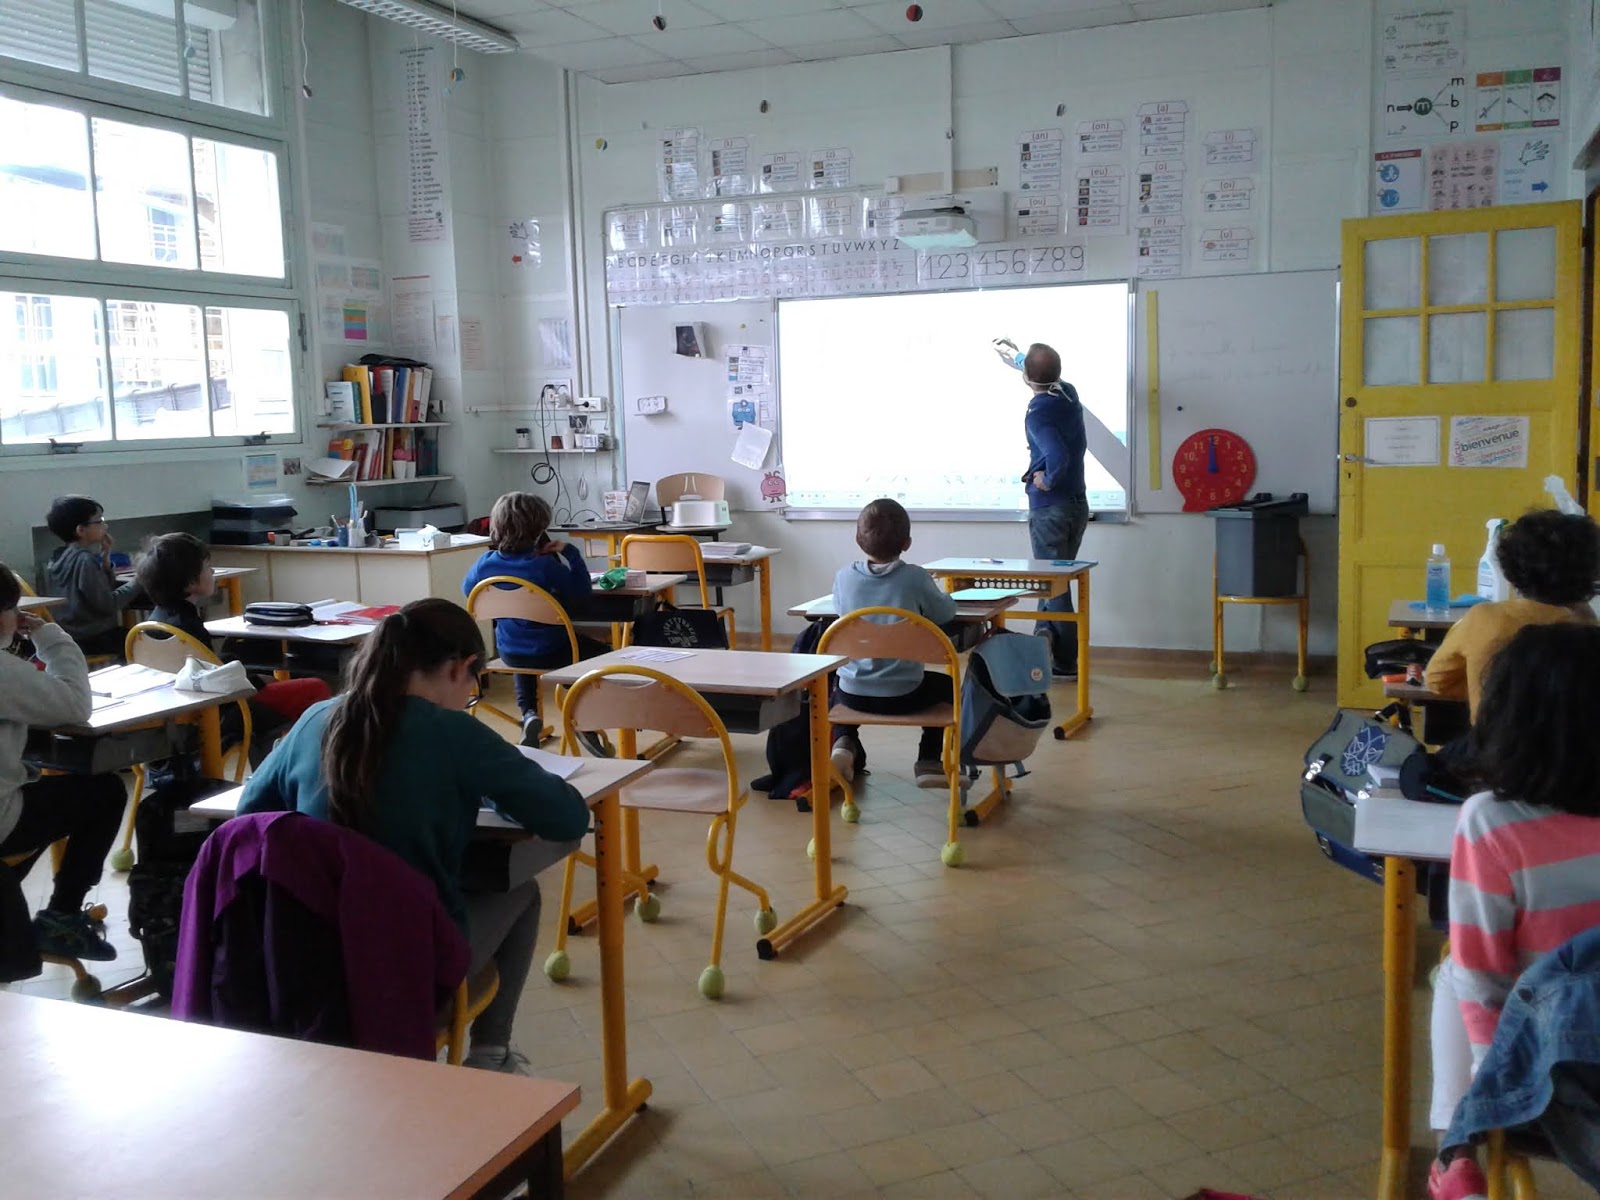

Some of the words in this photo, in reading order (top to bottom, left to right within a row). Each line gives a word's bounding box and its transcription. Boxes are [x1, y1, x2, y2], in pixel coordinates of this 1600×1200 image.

[1451, 77, 1464, 86] m
[1451, 94, 1459, 107] b
[1416, 102, 1430, 113] m
[1450, 121, 1458, 133] p
[1460, 429, 1520, 452] bienvenue
